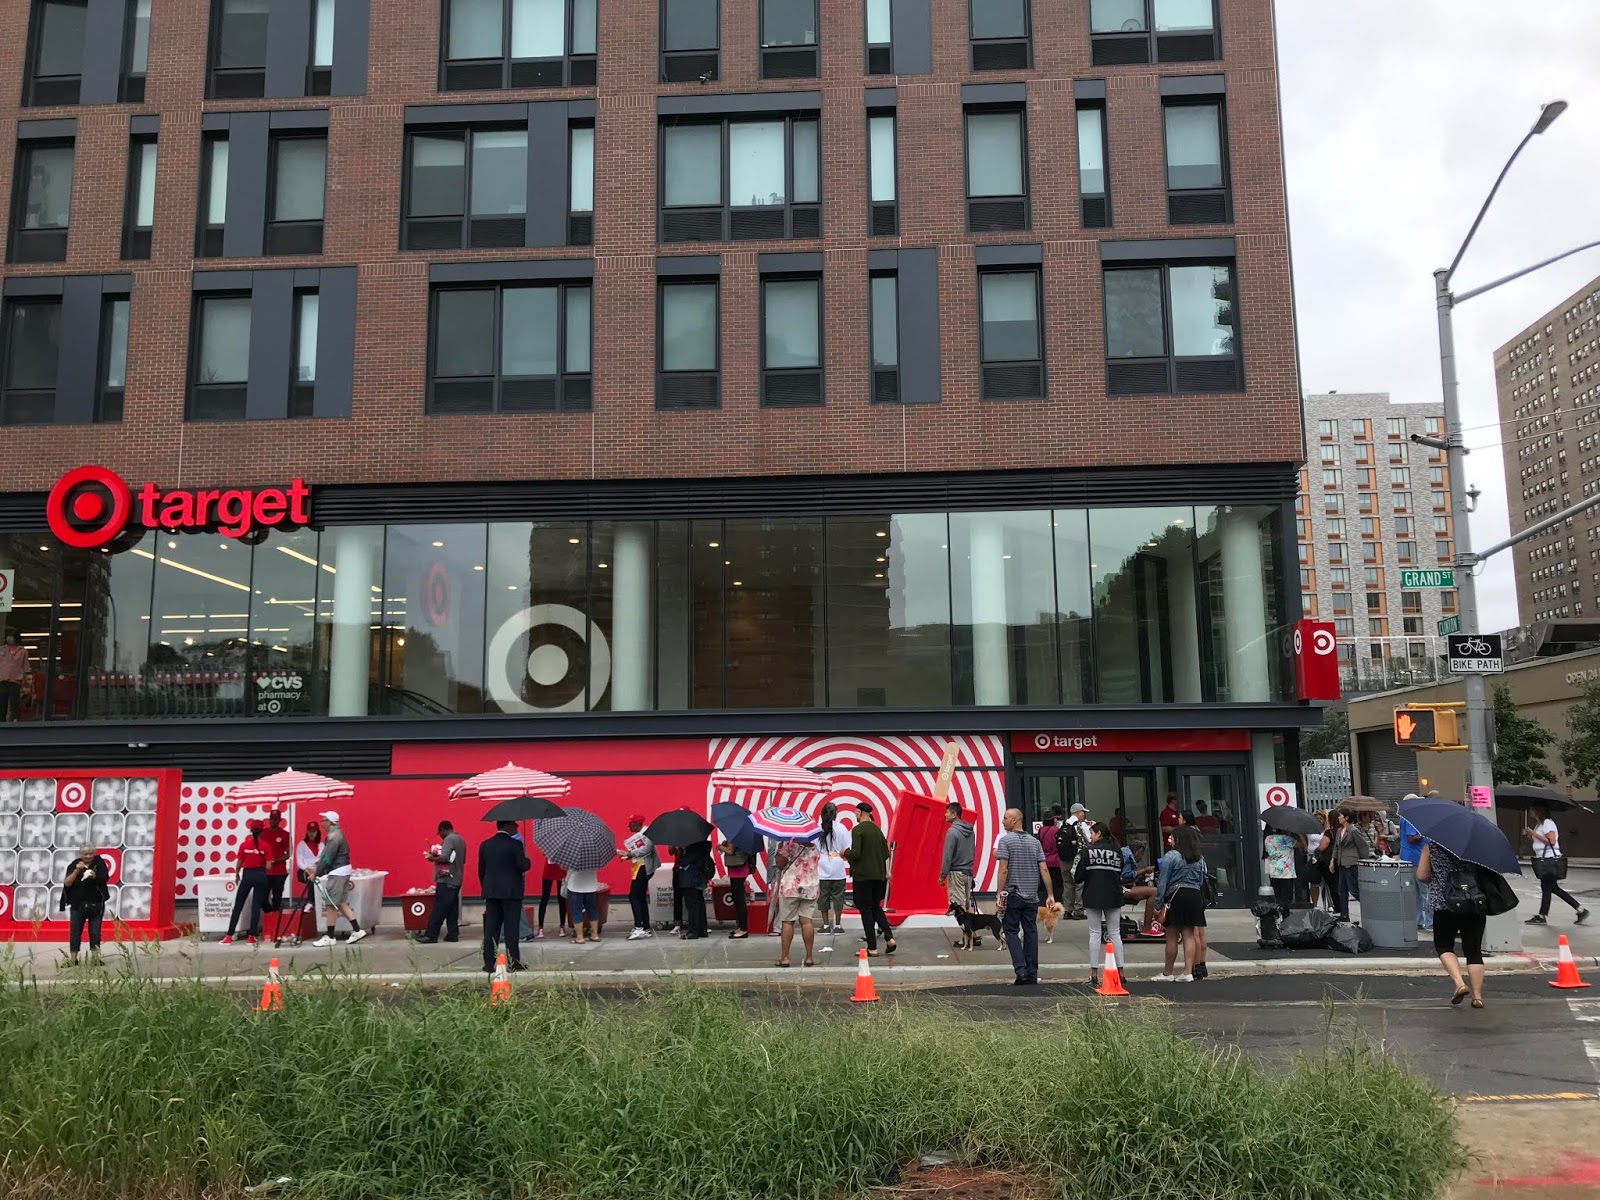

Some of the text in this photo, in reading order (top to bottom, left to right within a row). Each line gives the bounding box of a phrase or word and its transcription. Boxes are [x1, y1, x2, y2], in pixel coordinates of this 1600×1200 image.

[138, 478, 308, 538] target
[1405, 572, 1441, 586] GRAND
[1453, 660, 1499, 669] BIKE PATH
[272, 676, 302, 689] CVS
[258, 691, 301, 700] pharmacy
[257, 703, 267, 711] at
[1053, 735, 1097, 750] target
[1090, 858, 1121, 867] POLICE
